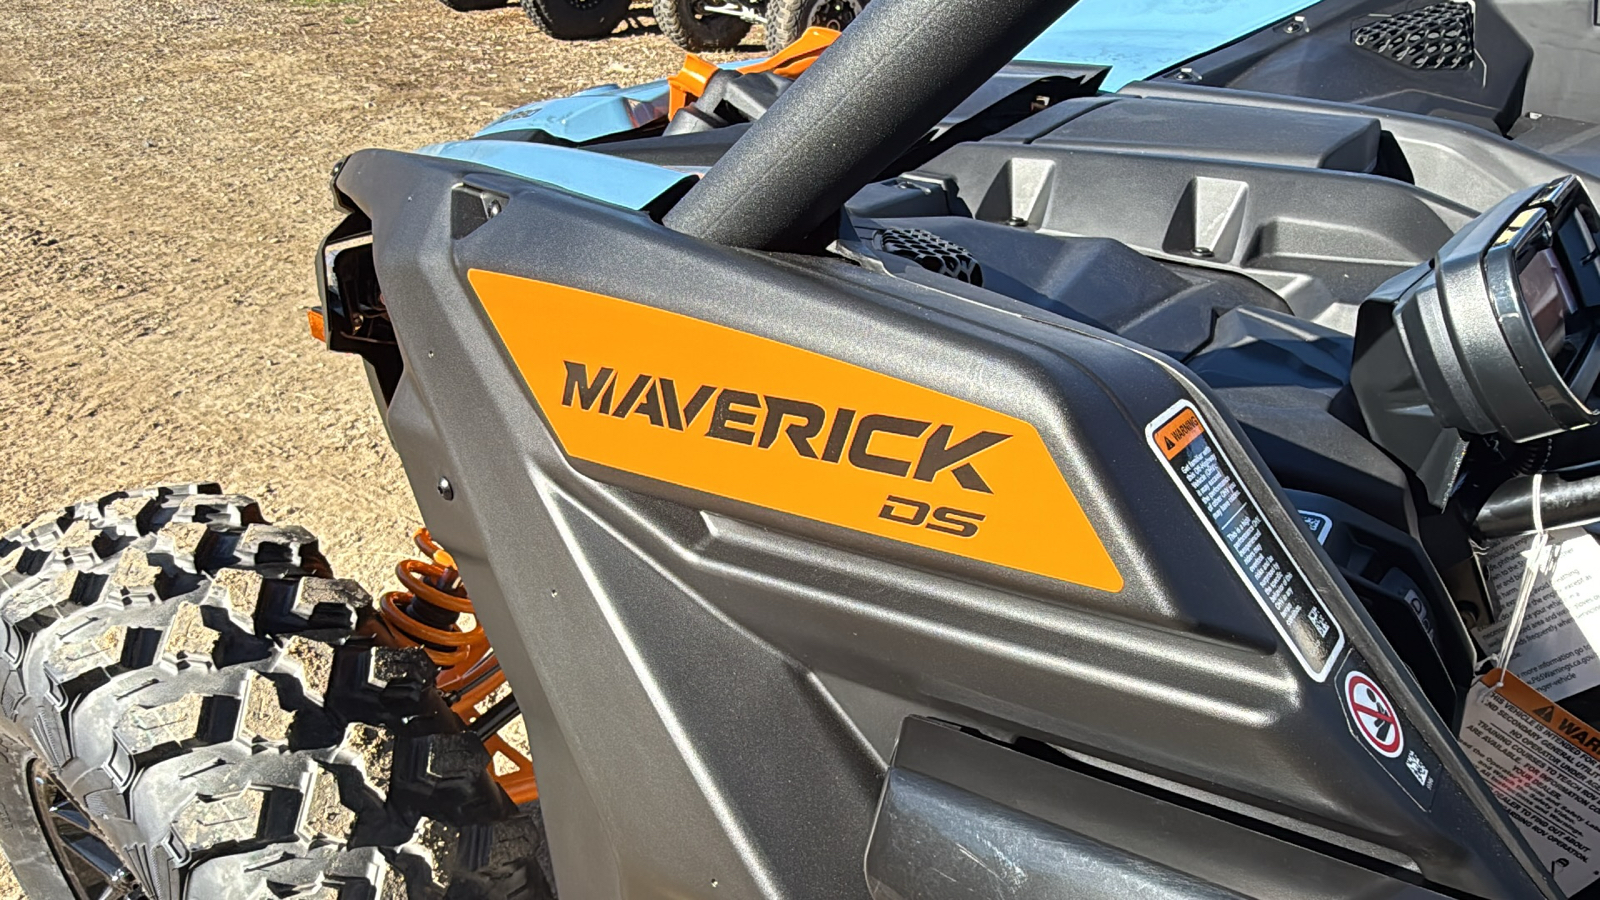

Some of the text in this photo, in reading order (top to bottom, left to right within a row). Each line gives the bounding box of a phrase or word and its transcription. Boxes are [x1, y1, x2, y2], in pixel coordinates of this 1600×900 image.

[562, 360, 1014, 494] MAVERICK
[1170, 415, 1199, 442] WARNING
[877, 494, 986, 538] DS
[1500, 568, 1508, 576] to
[1506, 563, 1519, 573] the
[1501, 575, 1515, 587] and
[1532, 580, 1550, 594] avoid
[1530, 595, 1542, 606] the
[1531, 606, 1547, 618] your
[1526, 623, 1557, 642] frequently
[1531, 619, 1544, 628] area
[1543, 611, 1557, 622] and
[1520, 665, 1538, 677] more
[1538, 650, 1574, 670] information
[1574, 647, 1584, 656] go
[1536, 670, 1576, 694] nger-vehicle
[1496, 710, 1541, 739] SECONDARY
[1540, 739, 1576, 763] GENERAL
[1575, 762, 1600, 780] UTILIT
[1503, 703, 1536, 725] VEHICLE
[1542, 729, 1581, 755] INTENDED
[1579, 753, 1597, 765] FOR
[1465, 724, 1482, 735] ARE
[1480, 734, 1523, 762] AVAILABLE.
[1522, 763, 1540, 774] FOR
[1538, 772, 1589, 806] INFORMATION
[1476, 721, 1599, 801] TRAINING COURSES TO TEACH ROV
[1508, 729, 1522, 738] NO
[1520, 737, 1560, 763] OPERATOR
[1559, 762, 1586, 780] UNDER
[1456, 738, 1472, 748] ead
[1472, 748, 1485, 757] the
[1484, 757, 1523, 782] Operator's
[1523, 781, 1549, 798] Guide
[1545, 796, 1560, 806] and
[1559, 805, 1584, 822] Safety
[1477, 760, 1492, 769] and
[1492, 769, 1515, 785] Watch
[1515, 784, 1529, 793] the
[1528, 793, 1553, 809] Safety
[1553, 808, 1576, 824] Video.
[1511, 766, 1562, 799] YOUR DEALER.
[1490, 776, 1534, 805] Instructions
[1533, 804, 1548, 814] and
[1548, 813, 1584, 837] Warnings.
[1520, 808, 1531, 816] TO
[1530, 814, 1548, 827] FIND
[1547, 825, 1565, 837] OUT
[1563, 835, 1590, 853] ABOUT
[1531, 825, 1548, 836] ROV
[1546, 834, 1589, 862] OPERATION.
